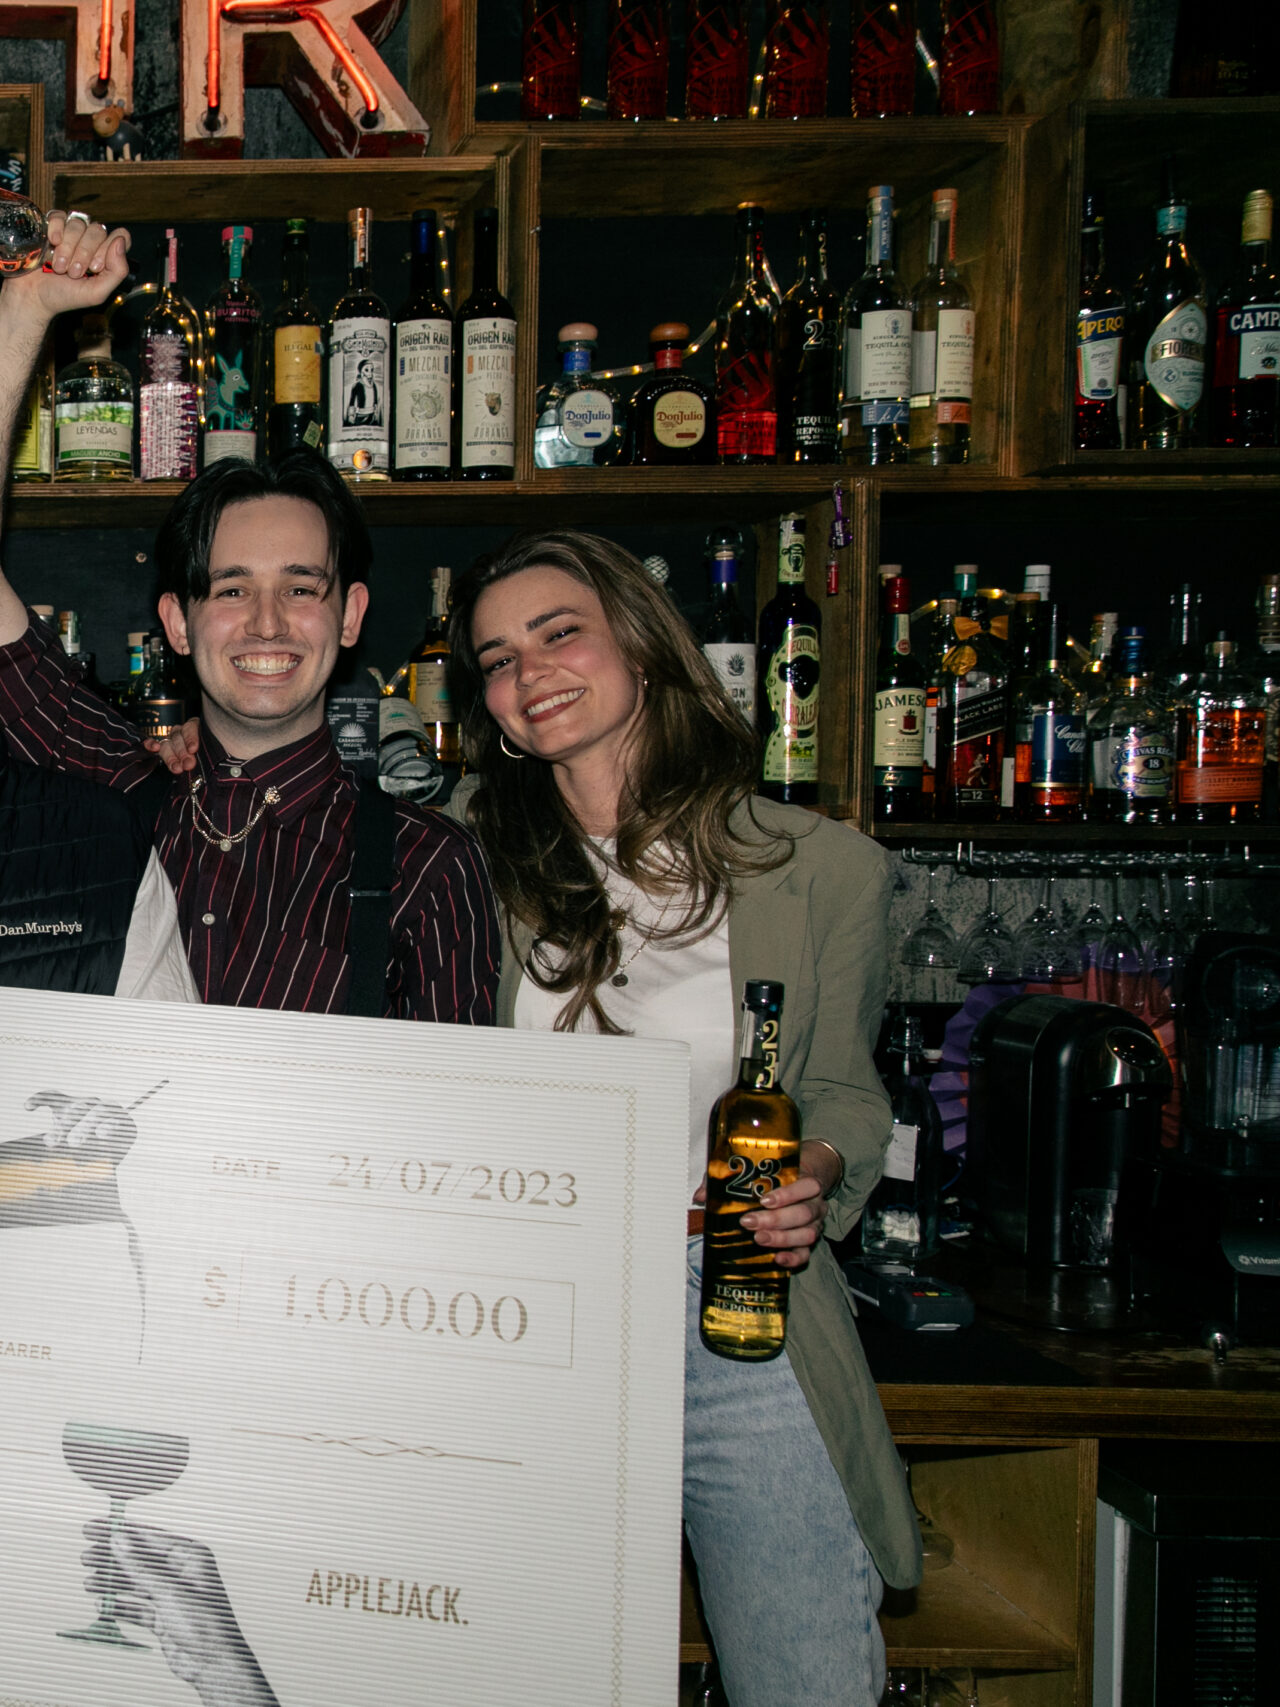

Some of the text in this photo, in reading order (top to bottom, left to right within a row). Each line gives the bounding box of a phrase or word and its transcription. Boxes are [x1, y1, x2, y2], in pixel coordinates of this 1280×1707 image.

[1230, 311, 1280, 331] CAMP
[409, 356, 441, 373] MEZCAL
[478, 355, 509, 371] MEZCAL
[76, 425, 118, 436] LEYENDAS
[1149, 759, 1160, 768] 18
[211, 1152, 578, 1208] DATE 24/07/2023
[725, 1155, 782, 1199] 23
[202, 1265, 529, 1343] $ 1,000.00
[304, 1568, 470, 1625] APPLEJACK.
